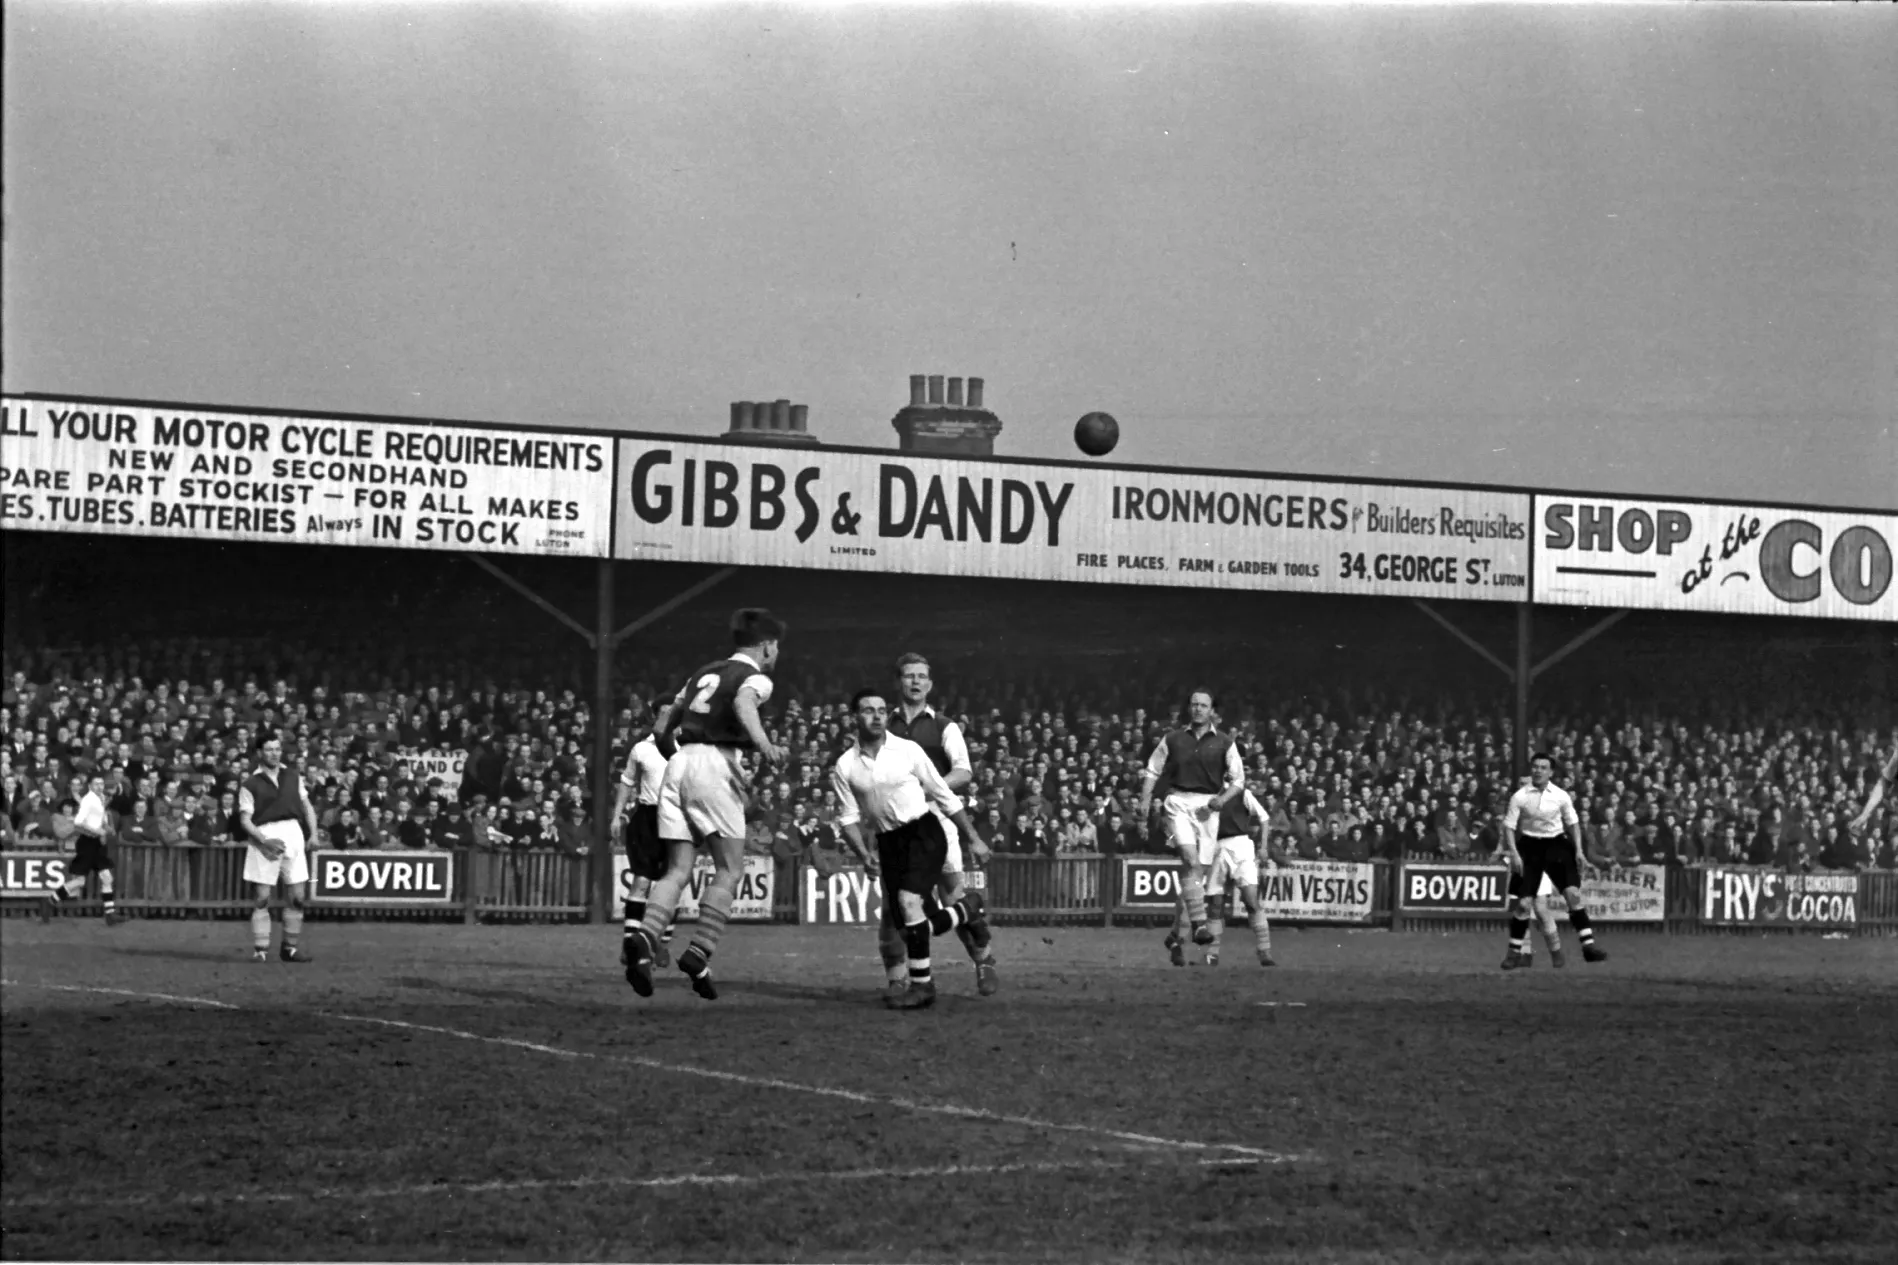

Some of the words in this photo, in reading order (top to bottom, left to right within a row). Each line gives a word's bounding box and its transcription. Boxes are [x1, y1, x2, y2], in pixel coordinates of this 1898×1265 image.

[48, 410, 137, 443] YOUR
[154, 417, 270, 451] MOTOR
[281, 425, 373, 457] CYCLE
[385, 430, 603, 472] REQUIREMENTS
[109, 449, 174, 471] NEW
[191, 454, 252, 476] AND
[273, 459, 468, 489] SECONDHAND
[88, 473, 166, 496] PART
[180, 478, 313, 505] STOCKIST
[354, 488, 407, 510] FOR
[419, 493, 474, 515] ALL
[488, 497, 580, 521] MAKES
[630, 449, 820, 544] GIBBS
[831, 492, 861, 535] &
[878, 463, 1074, 546] DANDY
[150, 502, 297, 534] BATTERIES
[307, 514, 363, 534] Always
[372, 514, 402, 540] IN
[416, 517, 521, 547] STOCK
[1112, 486, 1348, 531] IRONMONGERS
[1367, 502, 1436, 536] Builders
[1440, 507, 1525, 543] Requisites
[535, 539, 570, 548] LUTON
[549, 529, 585, 539] PHONE
[830, 546, 877, 557] LIMITED
[1077, 553, 1108, 568] FIRE
[1179, 558, 1214, 573] FARM
[1228, 561, 1277, 575] GARDEN
[1284, 563, 1320, 577] TOOLS
[1544, 503, 1692, 555] SHOP
[1681, 544, 1713, 594] at
[1720, 514, 1760, 560] the
[1759, 518, 1894, 605] CO
[1374, 554, 1457, 584] GEORGE
[1493, 573, 1525, 587] LUTON
[688, 673, 721, 714] 2
[408, 759, 447, 774] TAND
[0, 859, 66, 889] LES
[325, 860, 442, 890] BOVRIL
[1258, 875, 1293, 902] WAN
[1300, 874, 1368, 905] VESTAS
[1411, 876, 1501, 900] BOVRIL
[1787, 892, 1856, 922] COCOA
